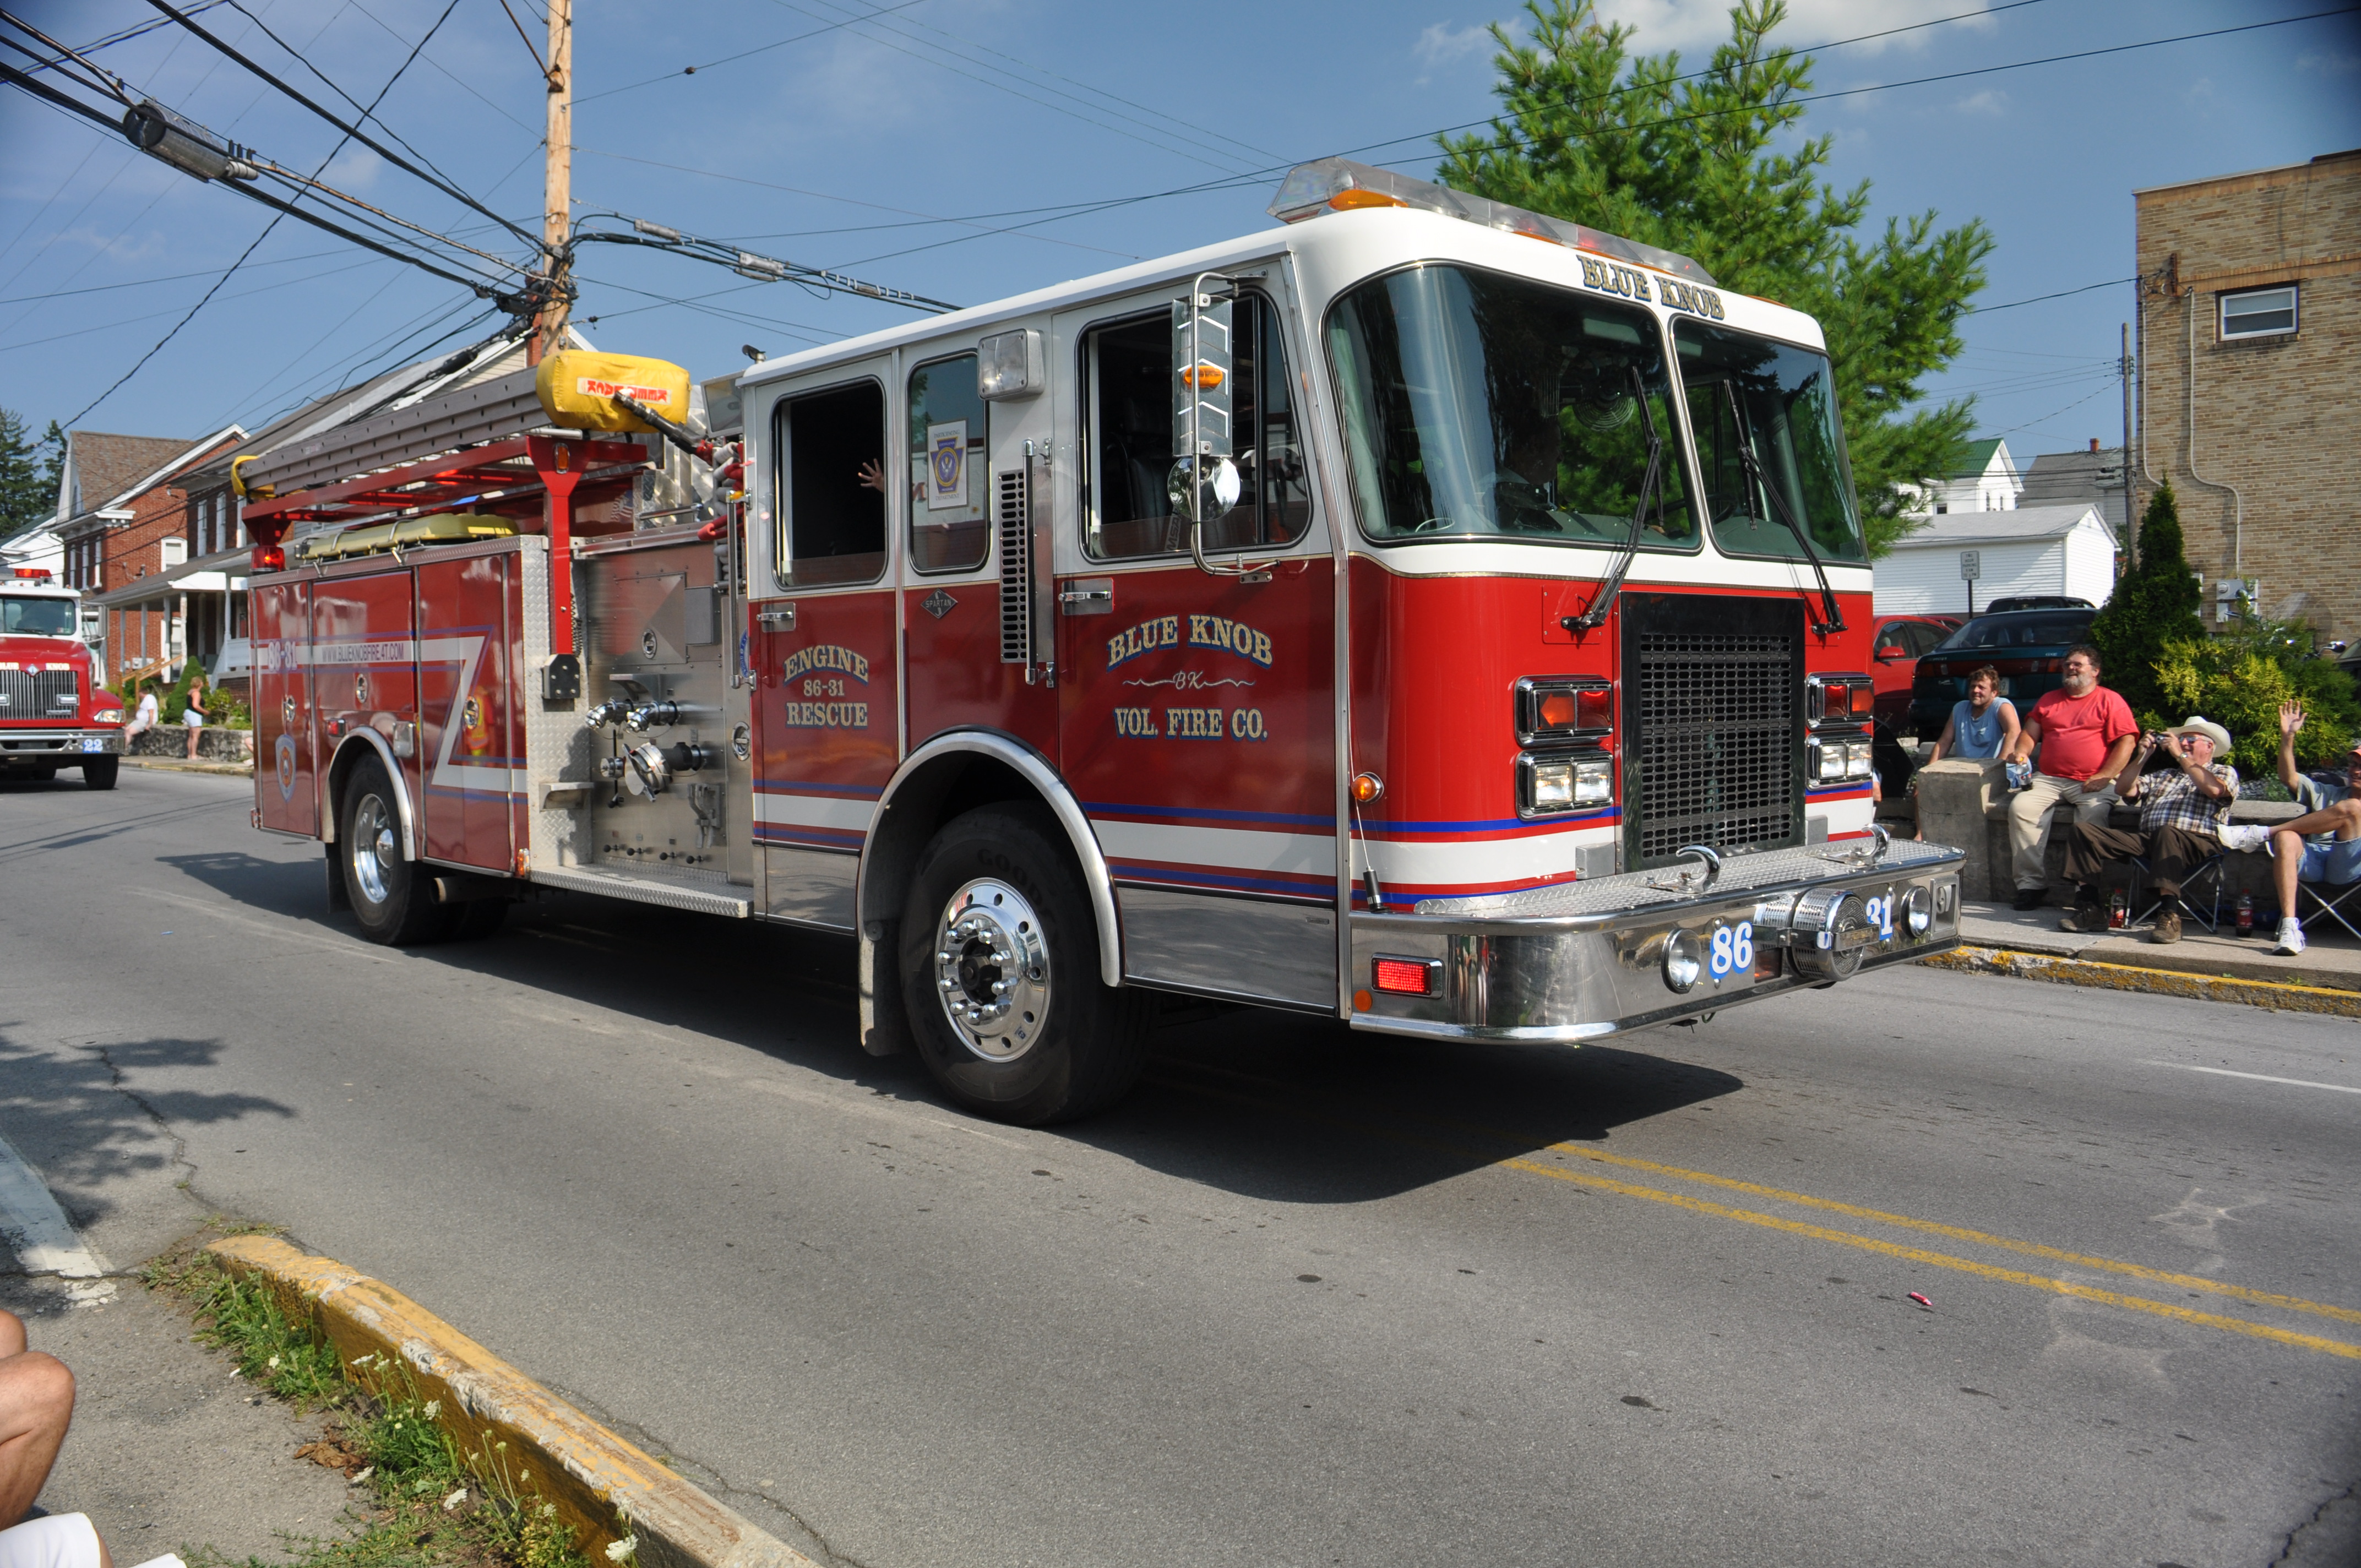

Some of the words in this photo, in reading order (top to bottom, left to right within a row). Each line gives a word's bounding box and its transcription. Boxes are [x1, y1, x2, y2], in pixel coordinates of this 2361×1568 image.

[1576, 254, 1651, 302] BLUE
[1653, 275, 1724, 320] KNOB
[926, 599, 951, 608] SPARTAN
[1107, 615, 1178, 671] BLUE
[1188, 614, 1272, 668] KNOB
[784, 645, 868, 685] ENGINE
[803, 679, 845, 697] 86-31
[786, 702, 868, 727] RESCUE
[1114, 707, 1158, 737] VOL.
[1166, 708, 1222, 737] FIRE
[1231, 708, 1267, 738] CO.
[84, 739, 103, 753] 22
[1866, 895, 1893, 936] 31
[1711, 922, 1753, 974] 86
